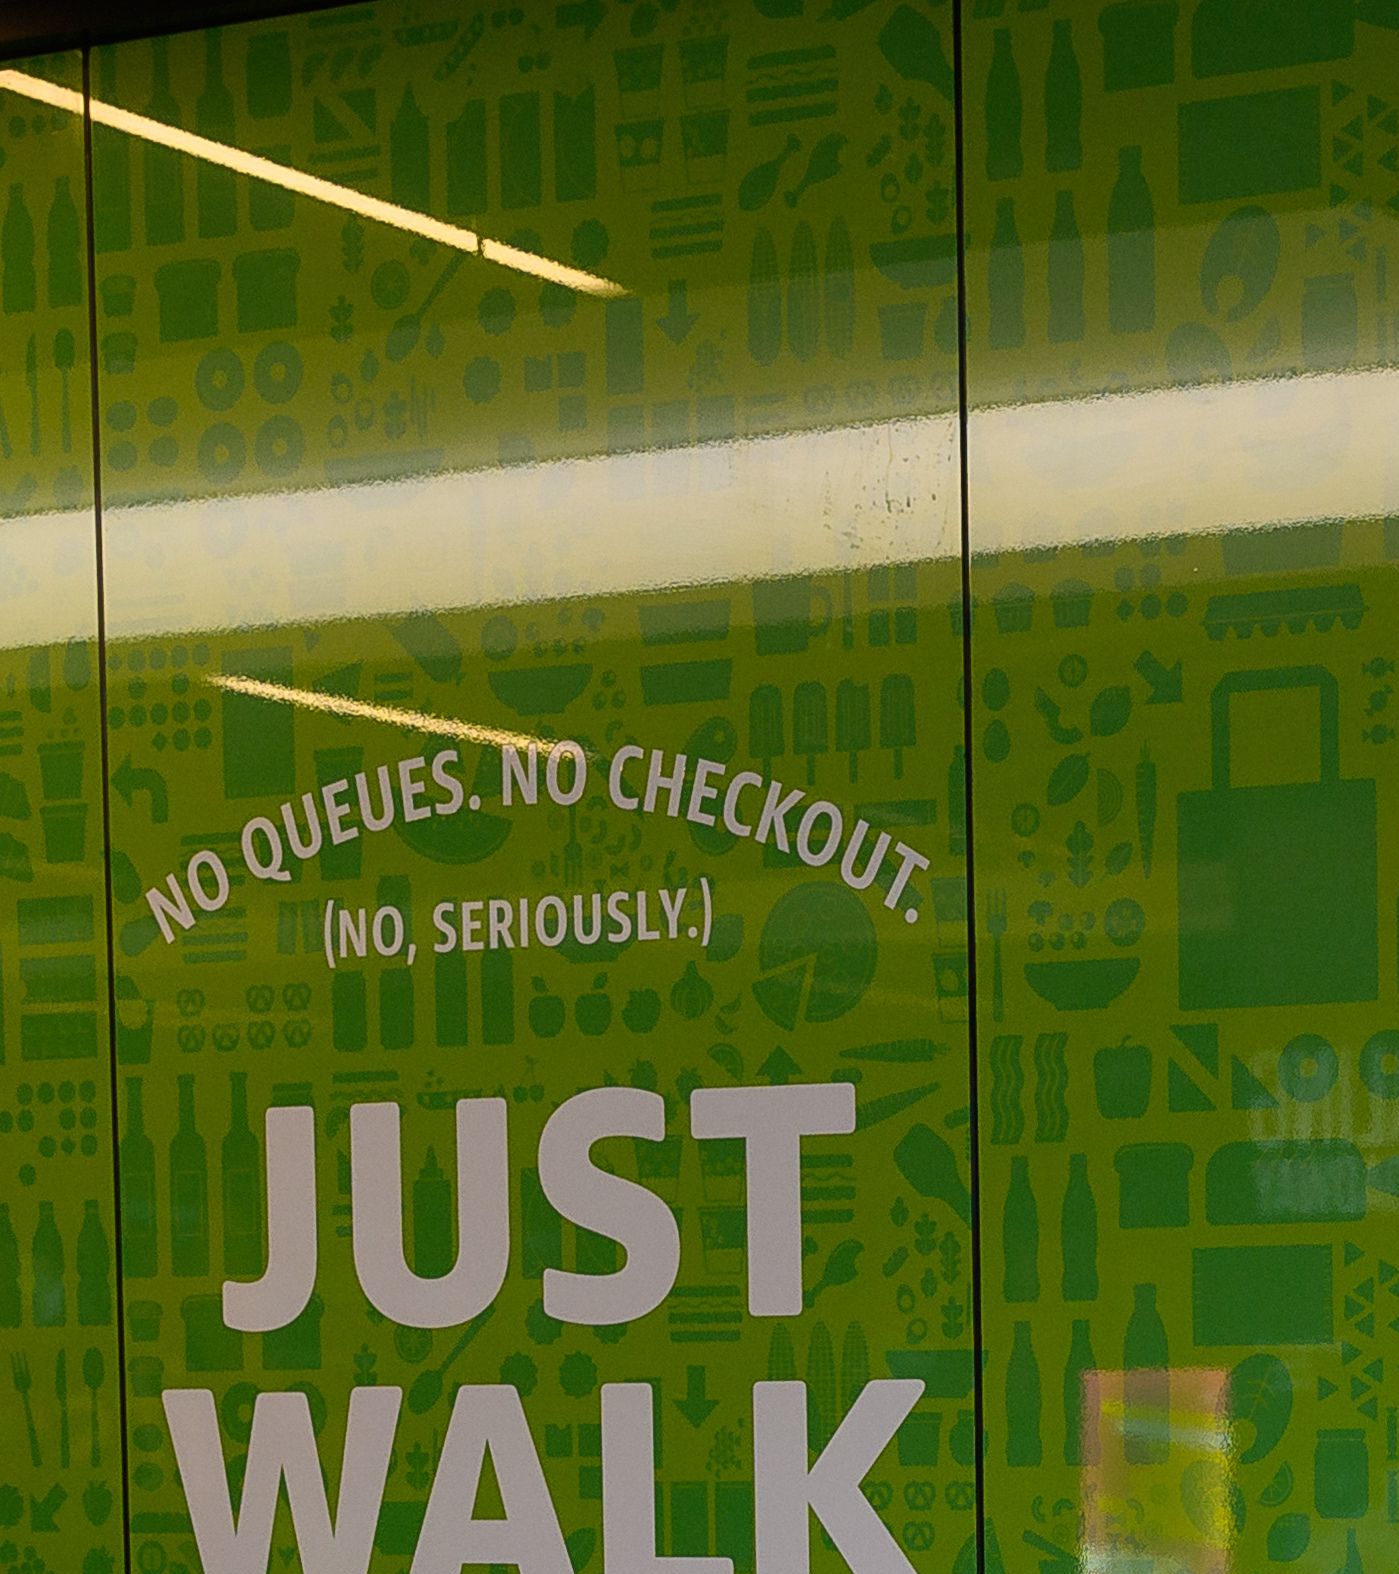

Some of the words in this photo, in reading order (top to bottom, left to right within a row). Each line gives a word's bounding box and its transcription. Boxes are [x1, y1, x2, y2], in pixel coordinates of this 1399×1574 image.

[145, 850, 231, 944] NO
[241, 749, 481, 882] QUEUES.
[501, 741, 588, 807] NO
[609, 745, 931, 924] CHECKOUT.
[323, 899, 416, 968] (NO,
[433, 877, 714, 953] SERIOUSLY.)
[222, 1082, 856, 1332] JUST
